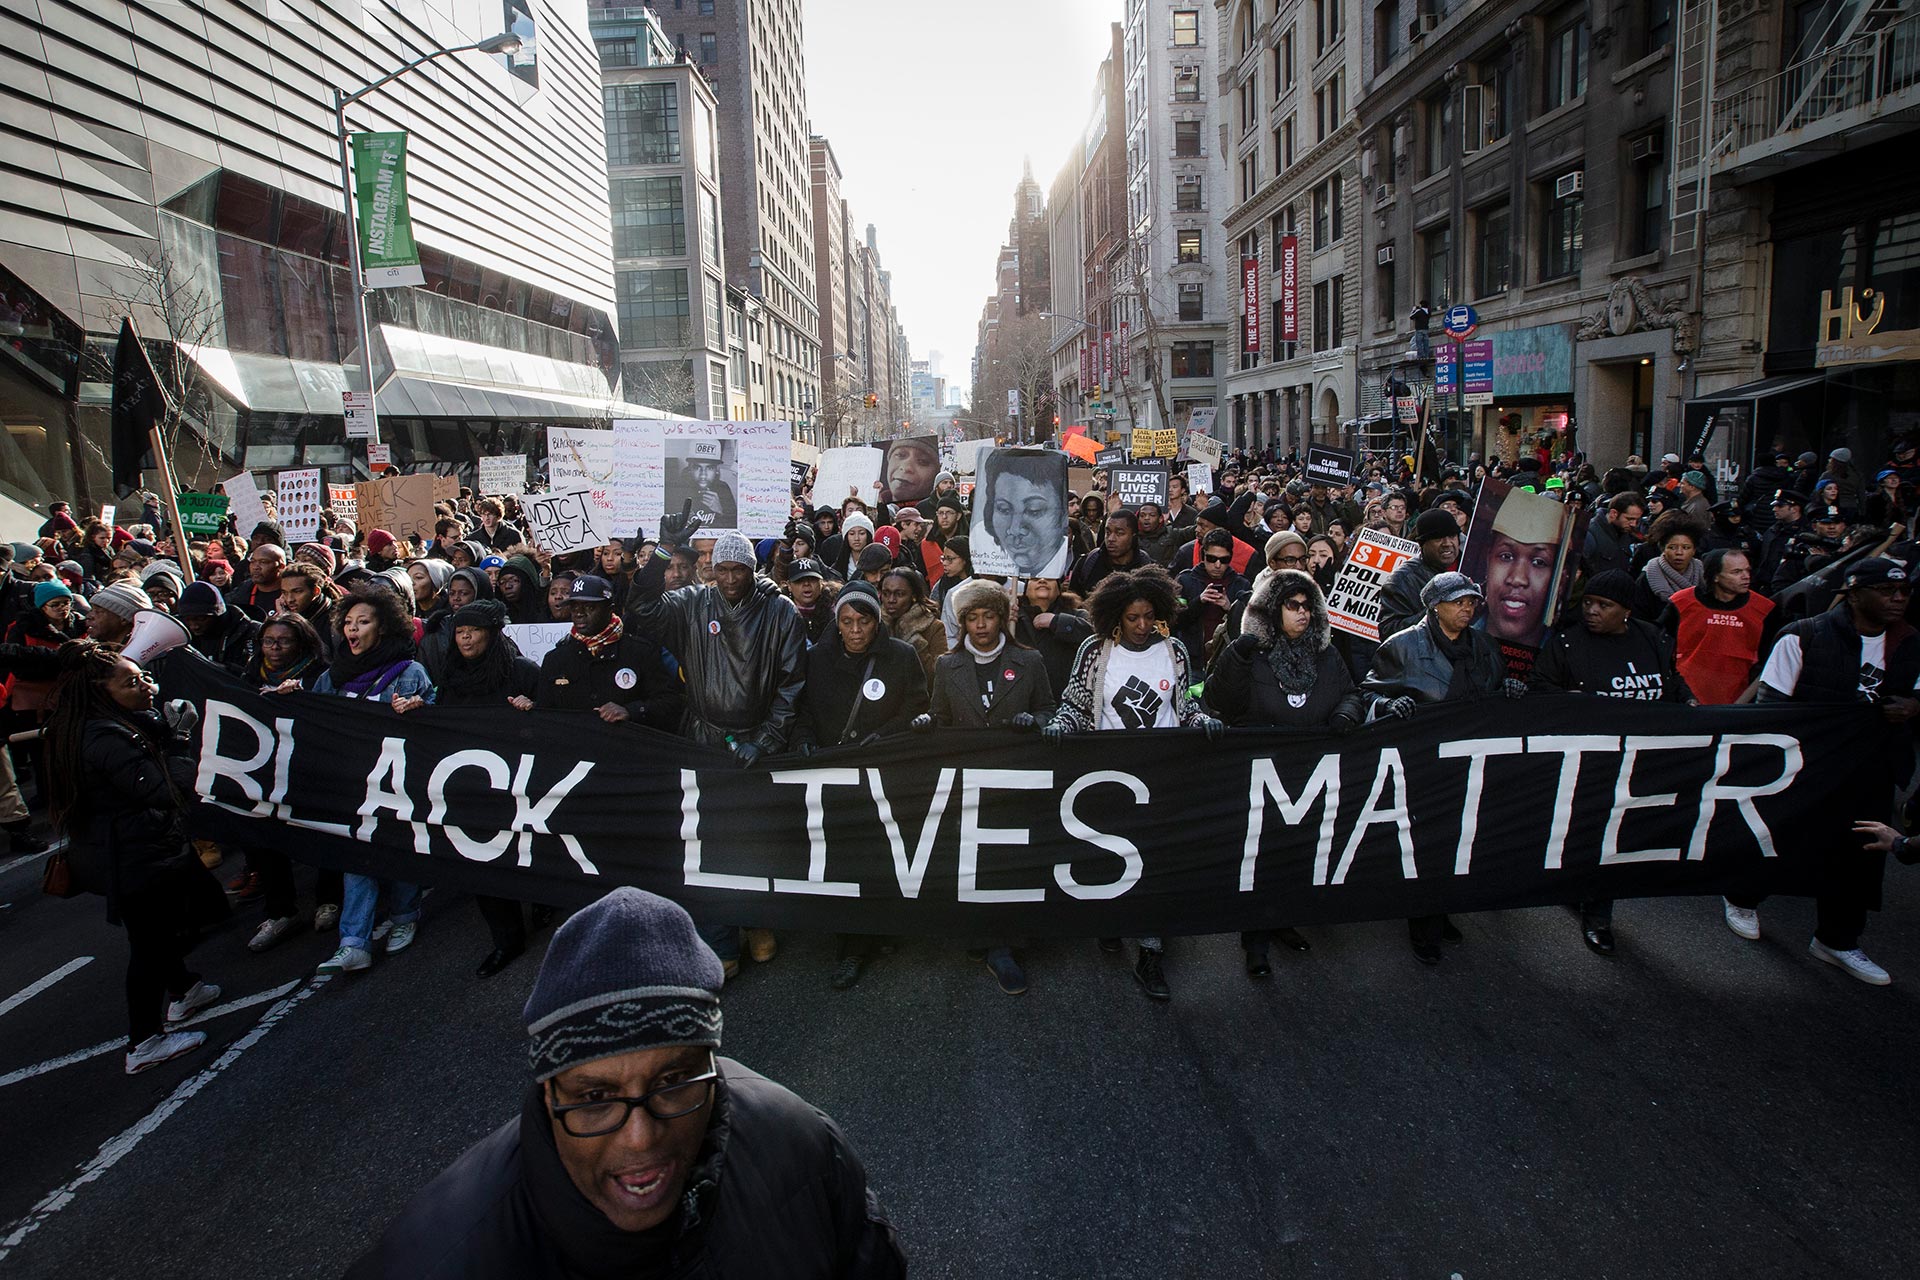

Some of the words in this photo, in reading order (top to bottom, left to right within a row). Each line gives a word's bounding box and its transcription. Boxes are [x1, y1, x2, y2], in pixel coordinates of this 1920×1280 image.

[368, 168, 394, 255] INSTAGRAM
[382, 151, 398, 165] IT
[387, 268, 399, 276] citi
[1284, 246, 1294, 287] SCHOOL
[1247, 268, 1256, 304] SCHOOL
[1284, 289, 1294, 312] NEW
[1248, 306, 1256, 326] NEW
[1285, 315, 1294, 334] THE
[1248, 329, 1257, 346] THE
[1437, 345, 1448, 353] M1
[1437, 365, 1449, 373] M3
[1437, 385, 1449, 393] M5
[697, 445, 715, 453] OBEY
[1697, 438, 1704, 447] TO
[1308, 464, 1328, 474] HUMAN
[1328, 468, 1349, 478] RIGHTS
[1321, 459, 1339, 468] CLAIM
[1118, 473, 1160, 483] BLACK
[357, 480, 416, 508] BLACK
[1120, 483, 1156, 493] LIVES
[188, 497, 228, 508] JUSTICE
[360, 508, 397, 525] LIVES
[534, 518, 601, 552] ERICA
[1361, 530, 1391, 547] FERGUSON
[1390, 538, 1398, 548] IS
[798, 558, 812, 570] NY
[1356, 545, 1407, 568] STO
[1343, 564, 1382, 586] POL
[573, 577, 585, 594] NY
[1336, 577, 1382, 604] BRUTA
[1328, 594, 1340, 608] &
[1343, 598, 1382, 622] MUR
[1706, 619, 1744, 628] RACISM
[1713, 613, 1738, 621] END
[1627, 662, 1636, 674] I
[1611, 673, 1663, 690] CAN'T
[196, 699, 599, 875] BLACK
[680, 768, 1150, 902] LIVES
[1239, 734, 1804, 892] MATTER
